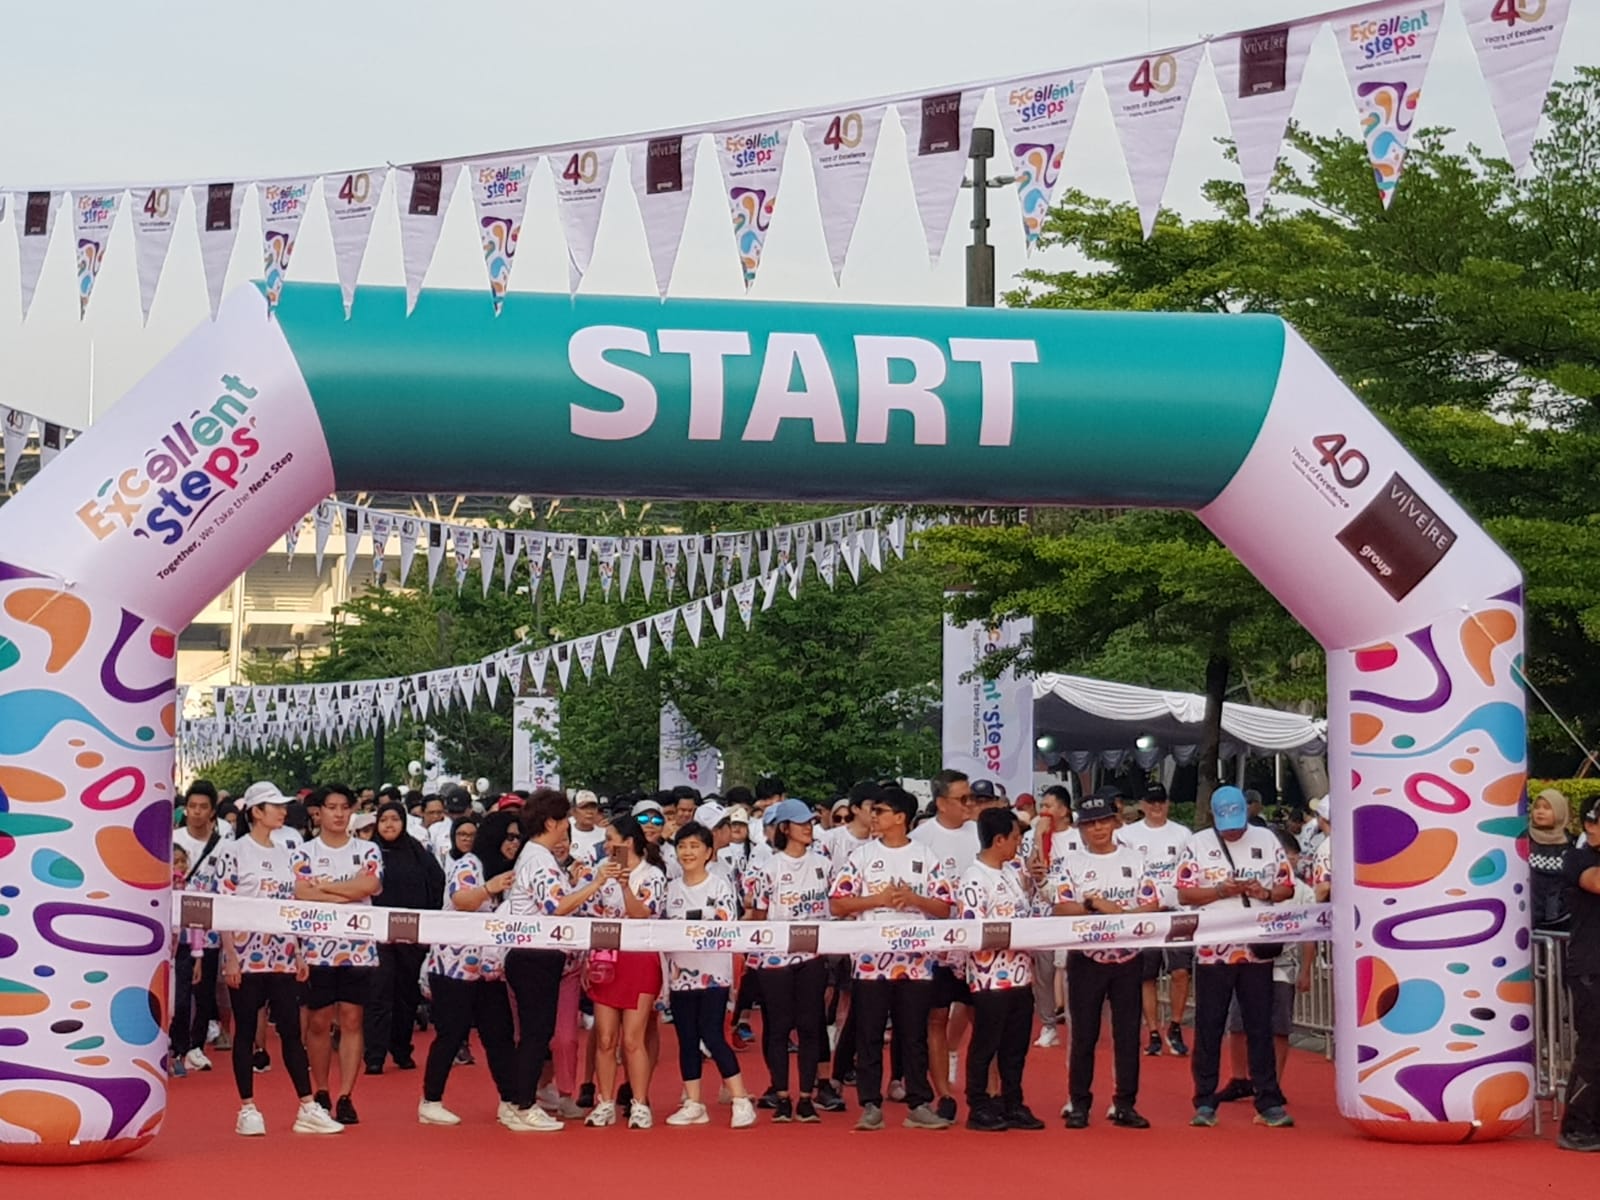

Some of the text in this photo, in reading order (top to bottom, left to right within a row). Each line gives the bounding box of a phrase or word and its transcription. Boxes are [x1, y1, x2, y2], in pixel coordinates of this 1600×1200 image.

[1129, 55, 1176, 97] 40
[824, 112, 863, 150] 40
[562, 151, 598, 185] 40
[143, 188, 170, 218] 40
[338, 172, 370, 205] 40
[567, 324, 1039, 446] START
[1312, 433, 1370, 489] 40
[199, 524, 216, 541] We
[213, 507, 235, 527] Take
[232, 492, 249, 509] the
[249, 470, 273, 495] Next
[270, 451, 294, 475] Step
[1359, 543, 1393, 577] group
[346, 911, 371, 930] 40
[550, 925, 574, 941] 40
[750, 929, 773, 945] 40
[943, 928, 967, 943] 40
[1132, 921, 1156, 936] 40
